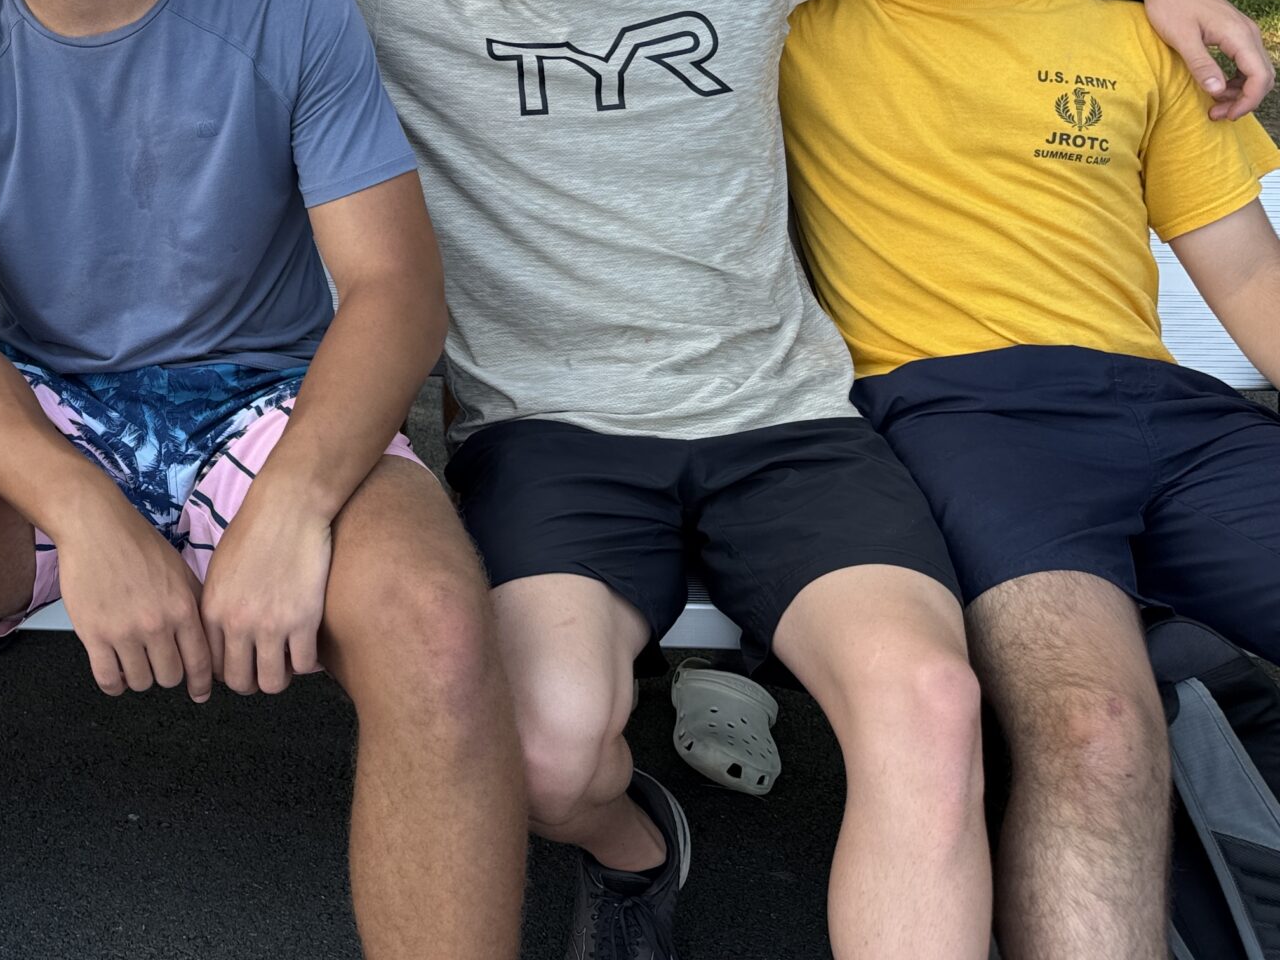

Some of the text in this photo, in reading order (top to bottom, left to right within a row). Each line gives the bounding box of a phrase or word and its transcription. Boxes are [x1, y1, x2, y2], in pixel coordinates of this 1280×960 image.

[485, 10, 734, 116] TYR
[1037, 70, 1117, 91] U.S. ARMY
[1045, 131, 1110, 152] JROTC
[1033, 149, 1111, 166] SUMMER CAMP
